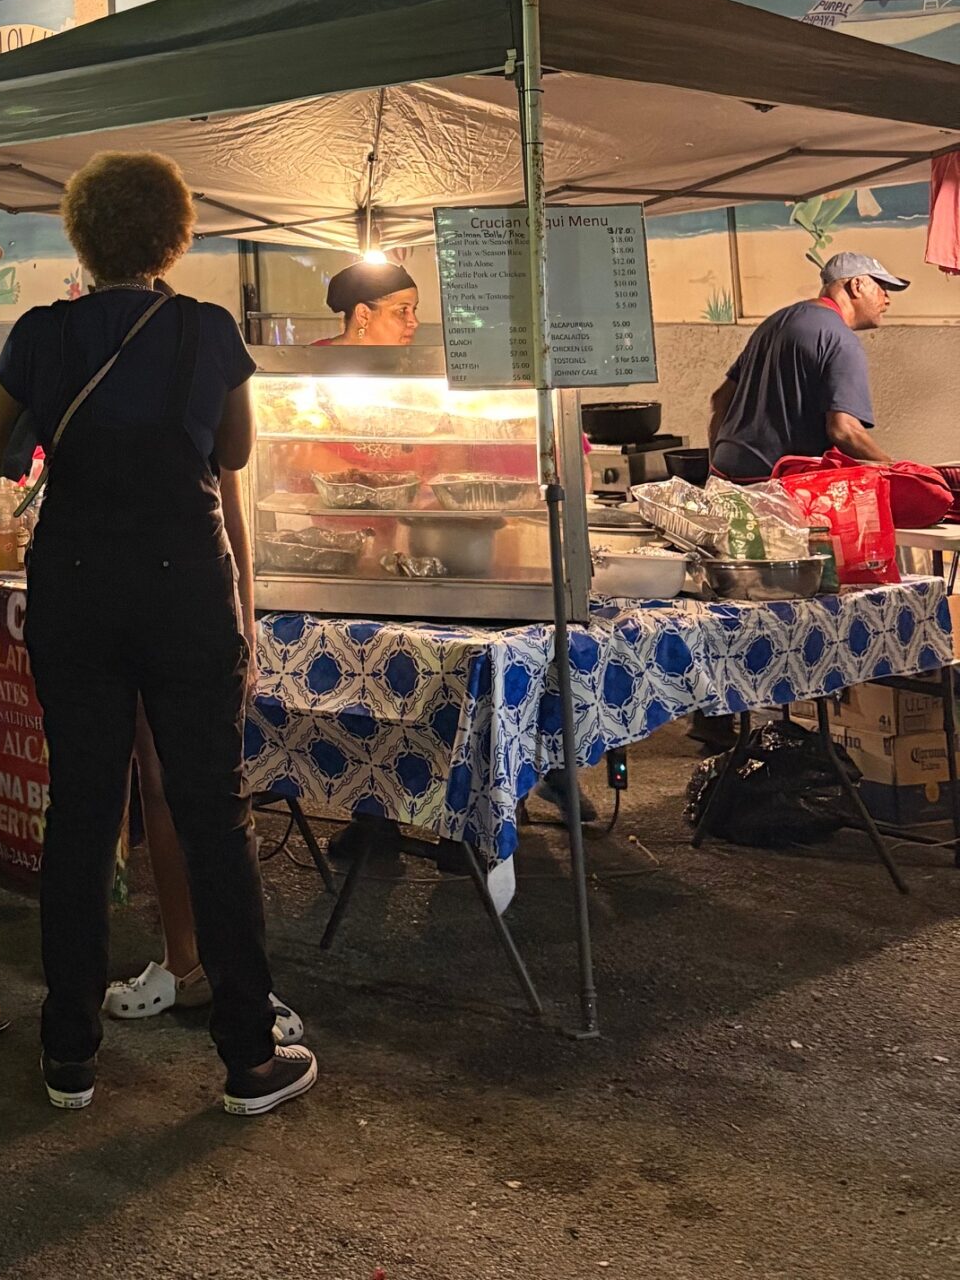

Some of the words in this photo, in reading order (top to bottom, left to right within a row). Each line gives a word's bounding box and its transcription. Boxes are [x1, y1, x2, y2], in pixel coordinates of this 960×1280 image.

[812, 0, 853, 14] PURPLE
[802, 15, 835, 27] PAPAYA
[470, 216, 521, 229] Crucian
[568, 215, 608, 227] Menu
